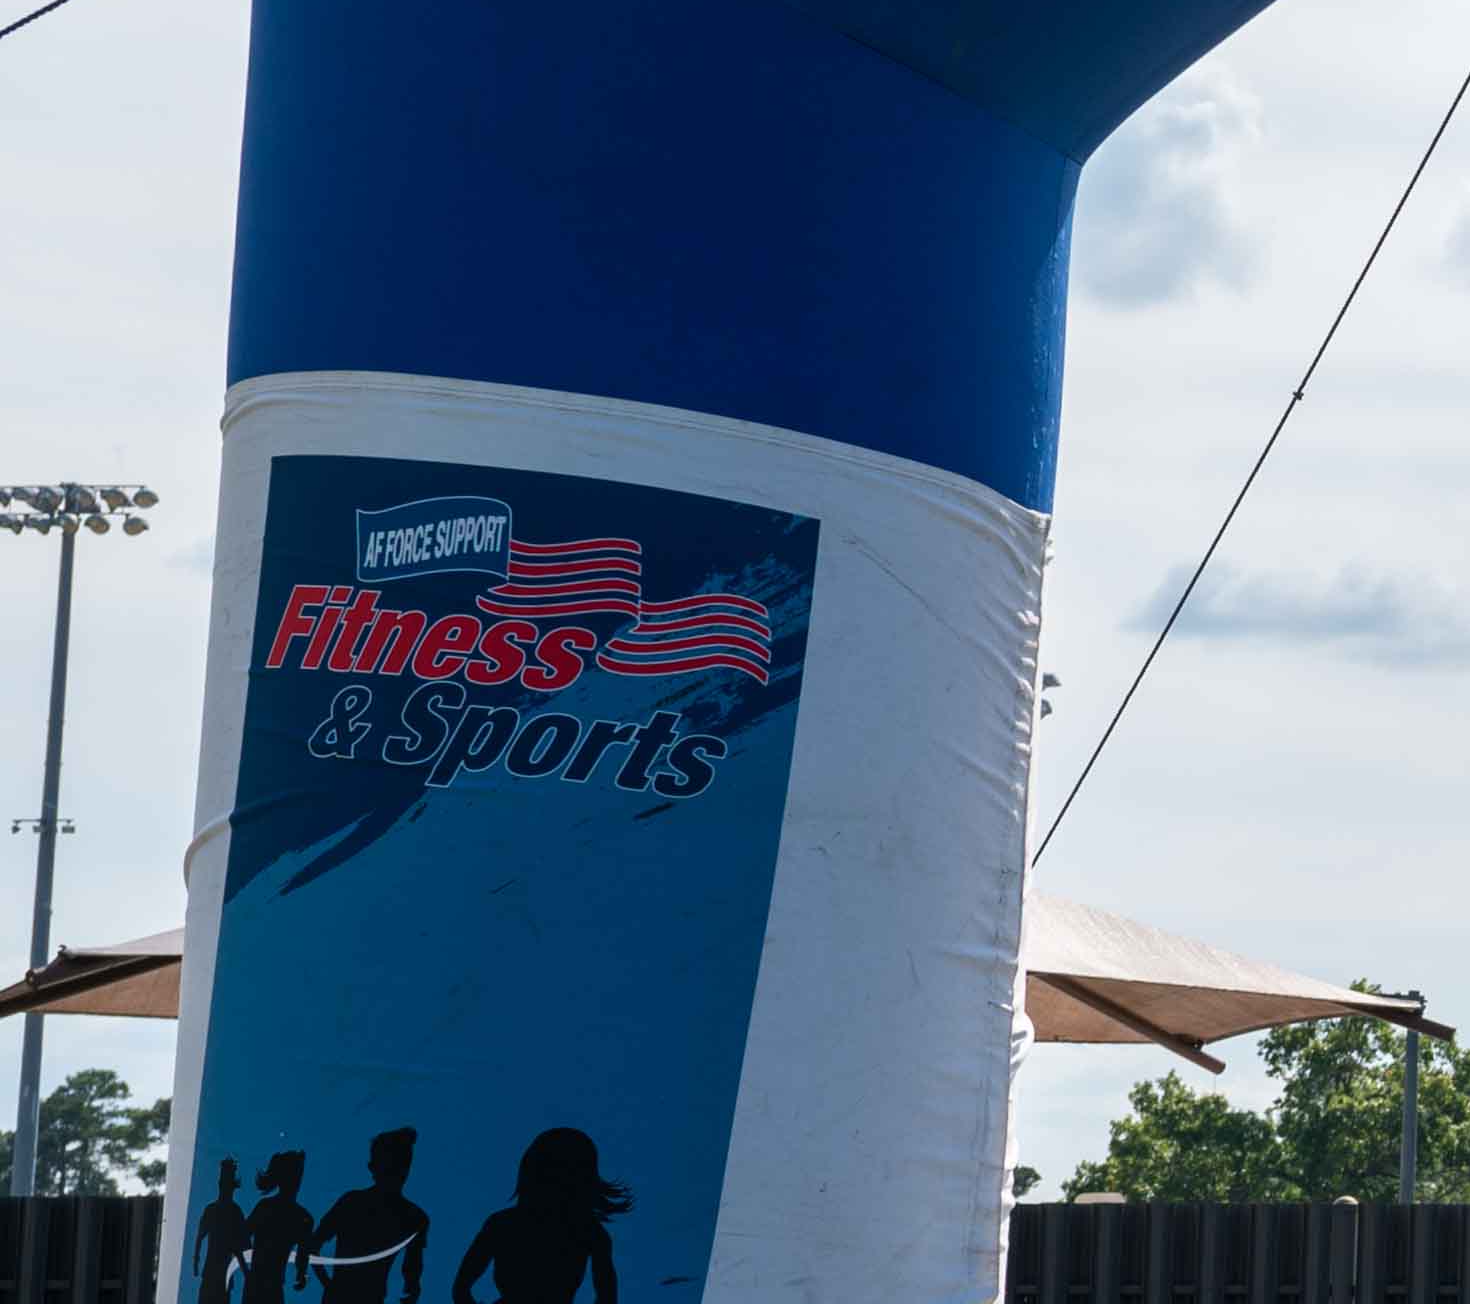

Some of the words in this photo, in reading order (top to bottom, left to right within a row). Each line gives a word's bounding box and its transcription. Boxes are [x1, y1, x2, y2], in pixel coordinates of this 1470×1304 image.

[363, 530, 385, 568] AF
[384, 523, 435, 567] FORCE
[434, 515, 507, 559] SUPPORT
[265, 583, 598, 691] Fitness
[307, 684, 373, 760] &
[382, 680, 728, 799] Sports
